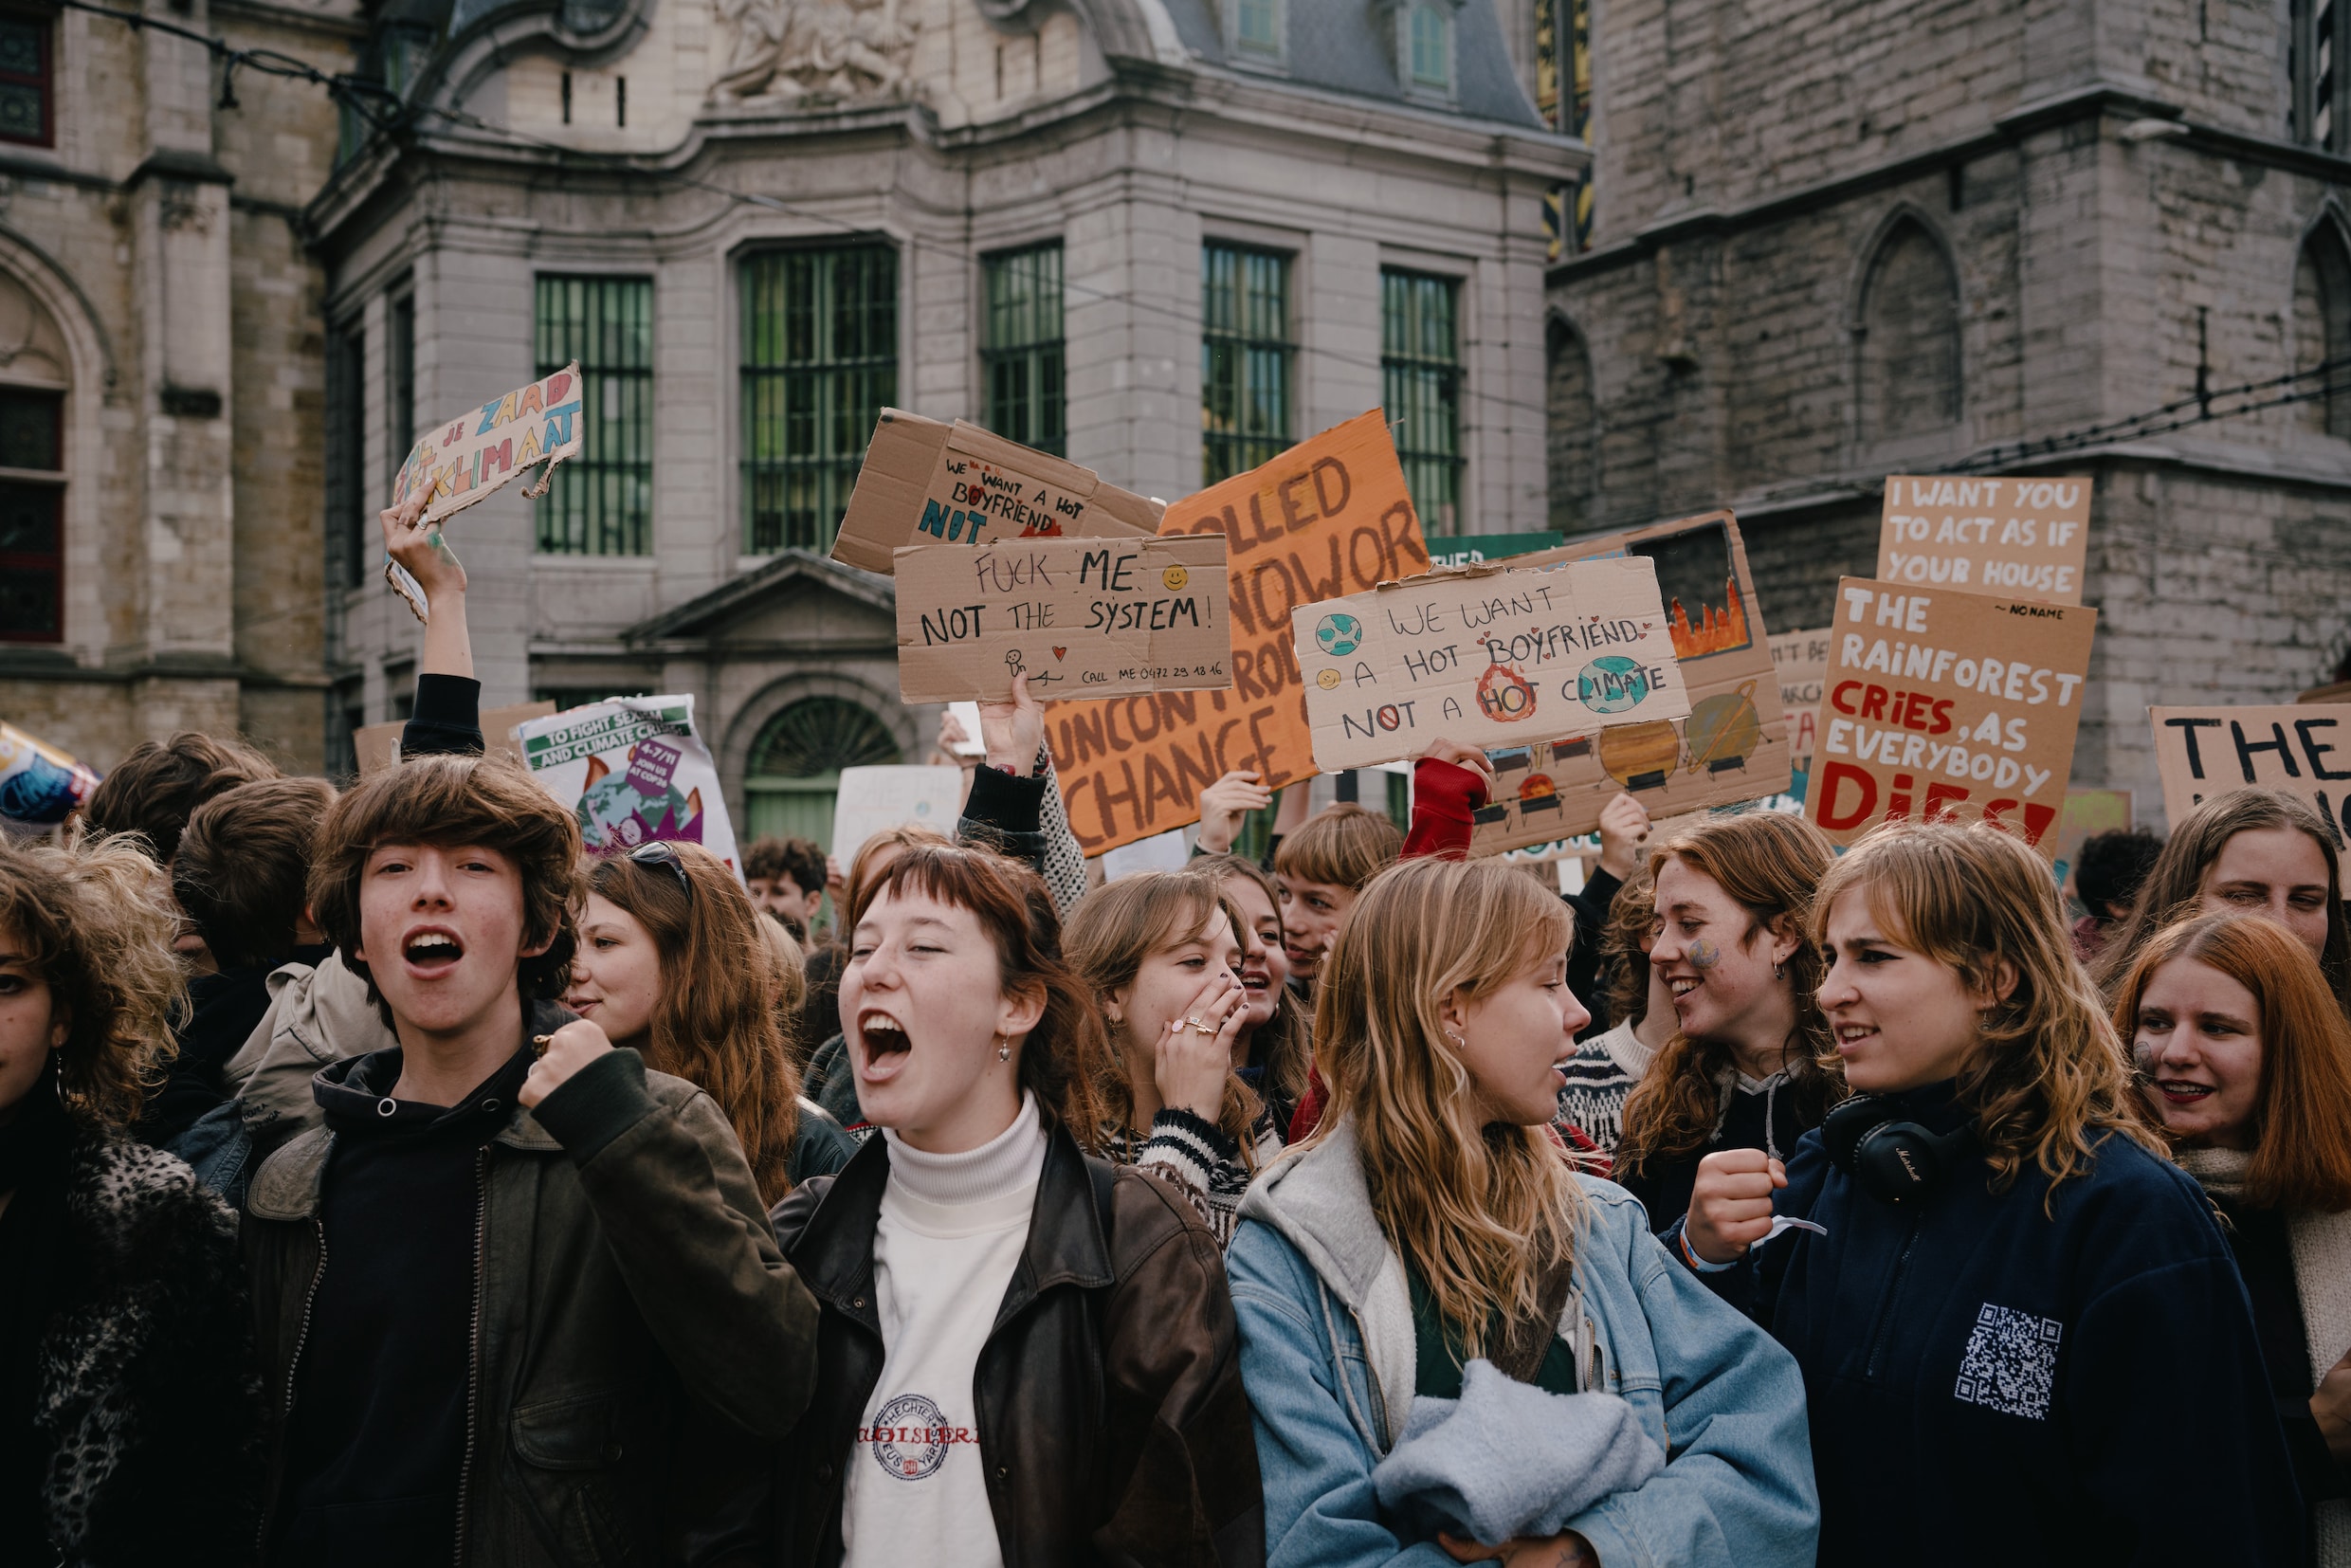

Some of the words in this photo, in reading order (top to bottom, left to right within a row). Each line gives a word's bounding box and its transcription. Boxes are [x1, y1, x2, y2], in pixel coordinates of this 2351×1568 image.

[443, 421, 465, 447] JE
[475, 373, 573, 436] ZAAD
[946, 459, 968, 475] WE
[981, 472, 1022, 496] WANT
[1033, 489, 1047, 506] A
[1055, 496, 1084, 520] HOT
[1891, 481, 1902, 507] I
[1911, 480, 2002, 507] WANT
[2014, 482, 2080, 509] YOU
[918, 497, 988, 544] NOT
[1888, 515, 1931, 543] TO
[1935, 516, 1996, 546] ACT
[1999, 518, 2037, 547] AS
[2047, 520, 2079, 547] IF
[975, 552, 1055, 593] FUCK
[1079, 549, 1139, 592] ME
[1886, 551, 1972, 583] YOUR
[1982, 560, 2076, 593] HOUSE
[920, 604, 986, 646] NOT
[1007, 602, 1055, 630] THE
[1084, 594, 1212, 635] SYSTEM!
[1387, 602, 1446, 636] WE
[1460, 586, 1552, 629] WANT
[1843, 587, 1932, 633] THE
[1082, 670, 1108, 684] CALL
[1119, 667, 1137, 680] ME
[1210, 661, 1223, 675] 16
[1354, 661, 1377, 688] A
[1403, 645, 1459, 683] HOT
[1341, 700, 1416, 739] NOT
[1442, 697, 1463, 720] A
[1478, 682, 1540, 714] HOT
[1560, 665, 1668, 702] CLIMATE
[540, 748, 574, 768] AND
[573, 732, 636, 759] CLIMATE
[546, 729, 569, 746] TO
[569, 716, 611, 742] FIGHT
[2164, 718, 2351, 784] THE
[629, 766, 642, 777] AT
[635, 757, 656, 773] JOIN
[655, 764, 667, 777] US
[1064, 704, 1292, 848] CHANGE
[1825, 718, 2052, 797] EVERYBODY
[1895, 1147, 1923, 1182] Marshall
[887, 1401, 935, 1424] HECHTER
